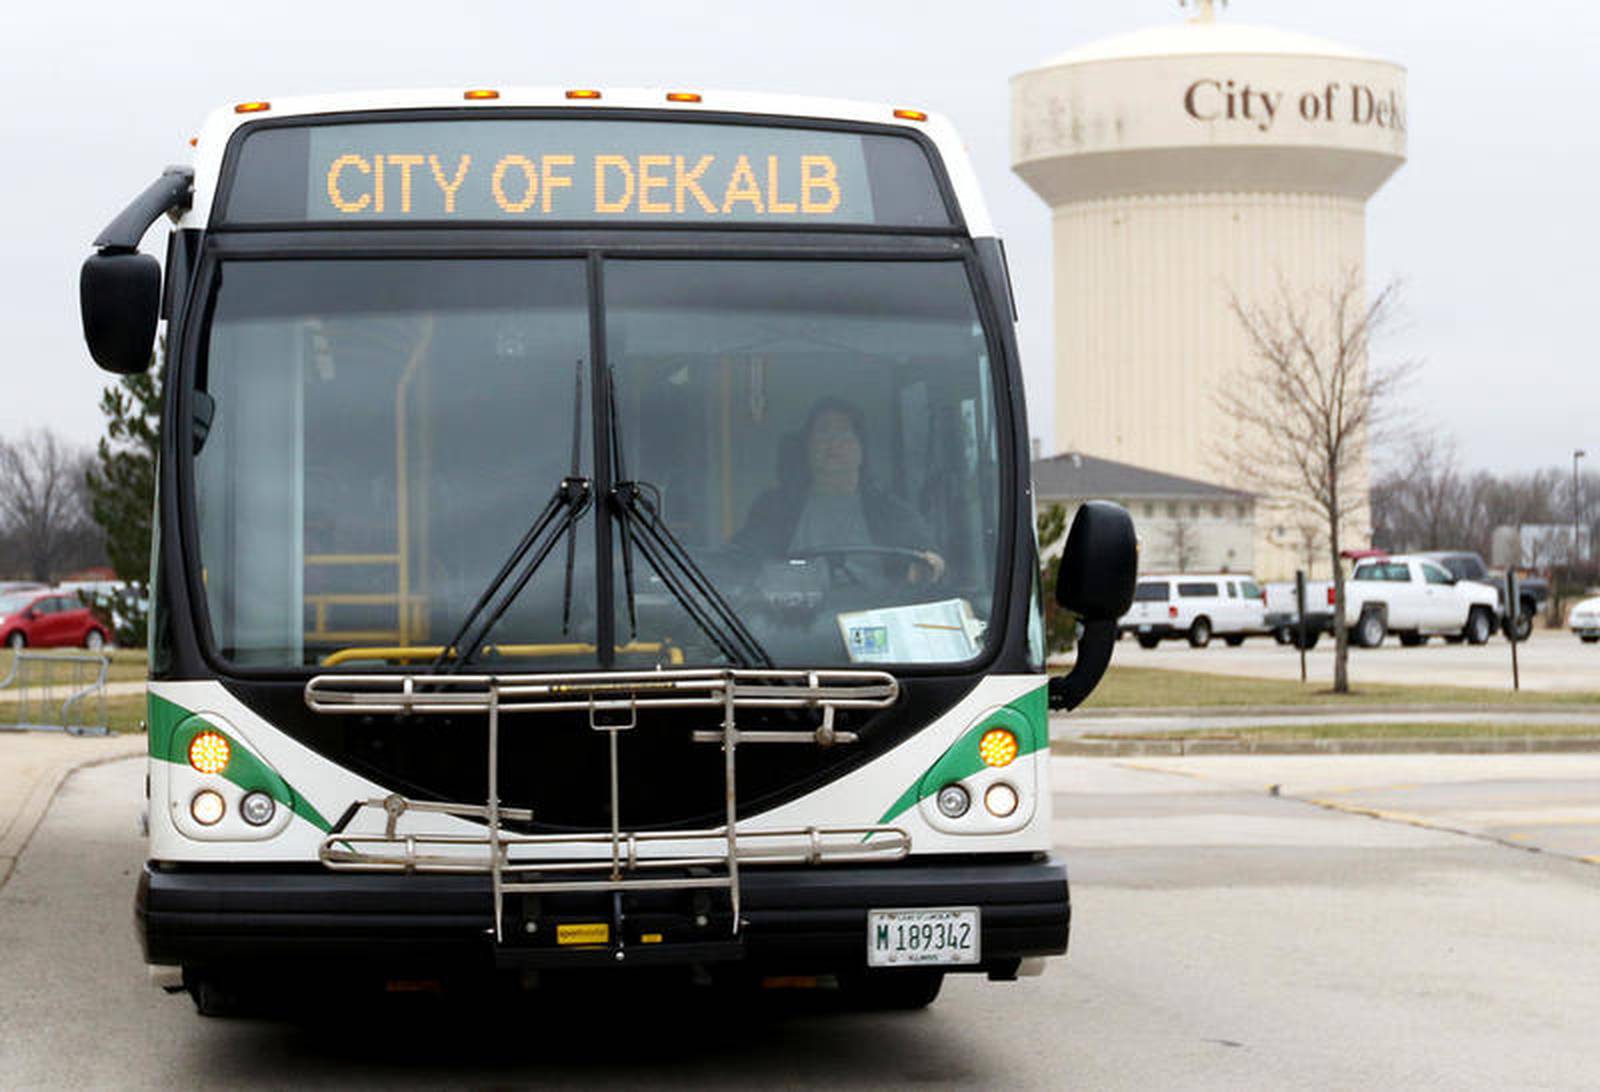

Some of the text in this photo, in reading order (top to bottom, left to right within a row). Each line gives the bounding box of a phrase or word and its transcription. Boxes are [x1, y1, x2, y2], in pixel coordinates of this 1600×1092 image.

[1184, 78, 1282, 131] City
[1299, 83, 1340, 122] of
[327, 154, 841, 213] CITY OF DEKALB
